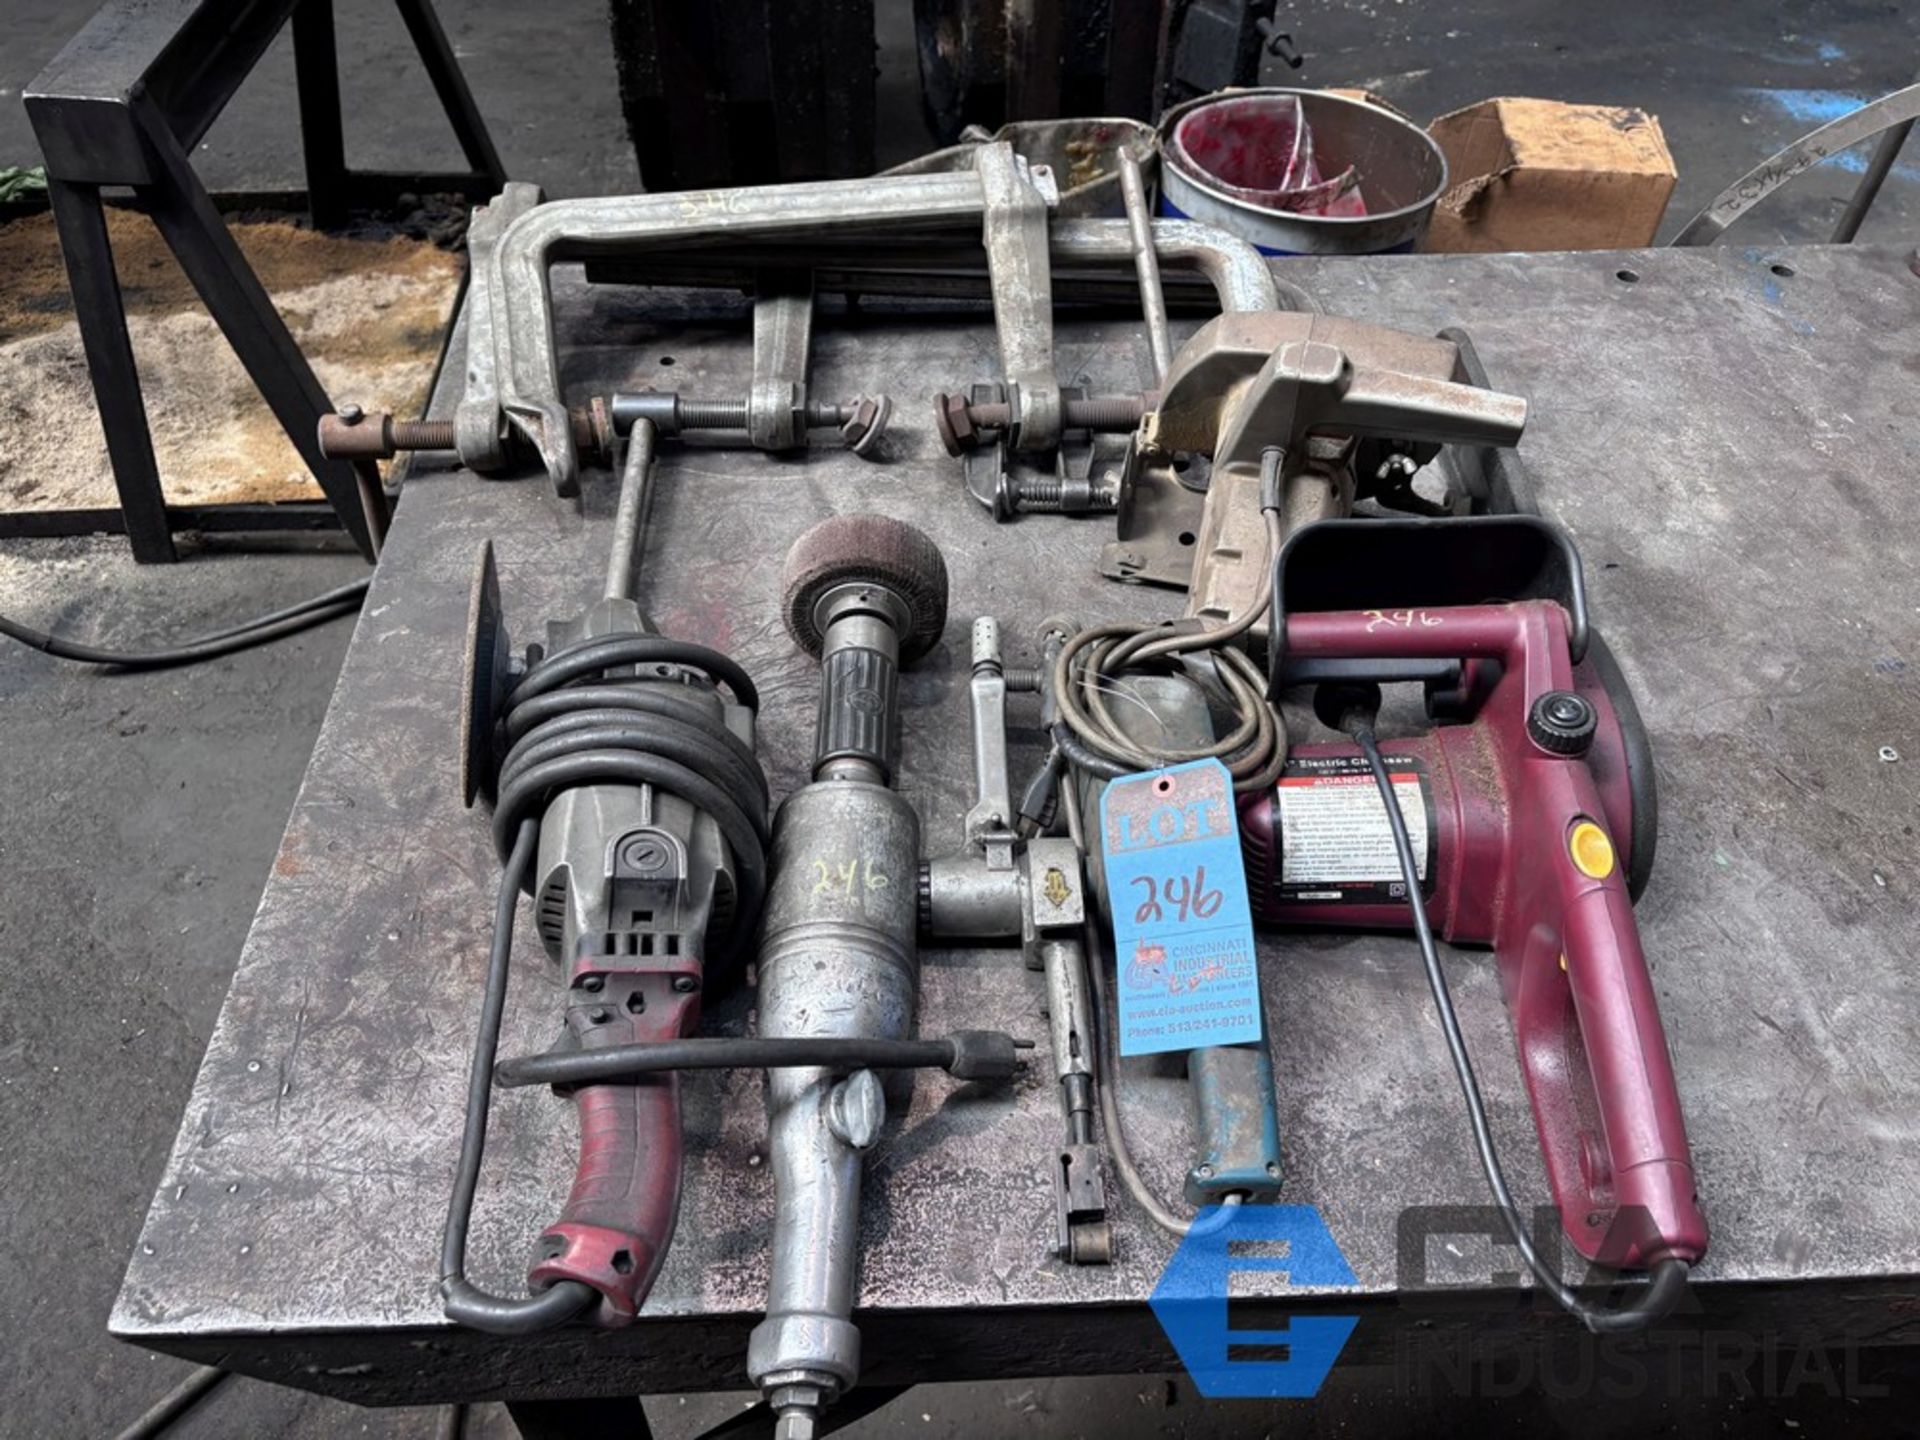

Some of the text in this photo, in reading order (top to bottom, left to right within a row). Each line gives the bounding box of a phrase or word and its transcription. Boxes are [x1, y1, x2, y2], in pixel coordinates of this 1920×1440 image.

[1363, 610, 1444, 632] 246
[1299, 759, 1348, 768] Electric
[1117, 799, 1217, 849] LOT
[812, 858, 889, 898] 246
[1130, 865, 1224, 924] 246
[1171, 938, 1248, 958] CINCINNATI
[1174, 952, 1252, 972] INDUSTRIAL
[1127, 1025, 1165, 1038] Phone:
